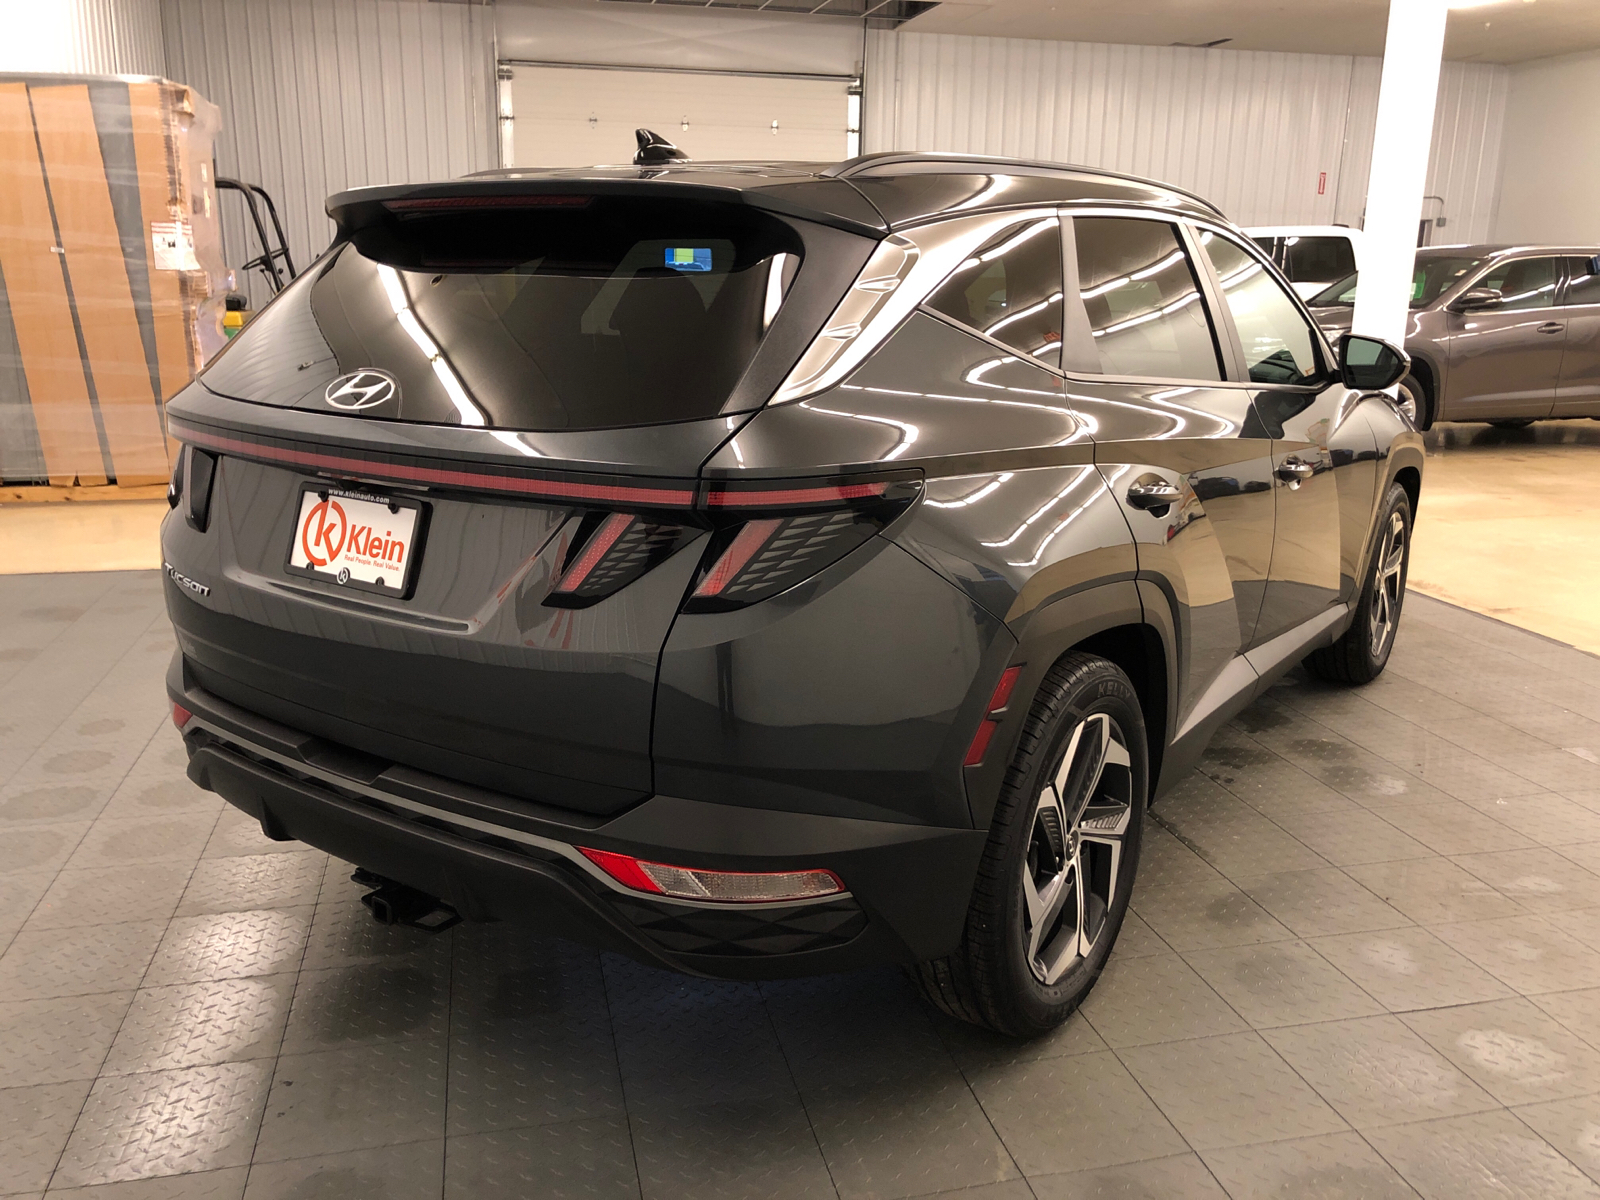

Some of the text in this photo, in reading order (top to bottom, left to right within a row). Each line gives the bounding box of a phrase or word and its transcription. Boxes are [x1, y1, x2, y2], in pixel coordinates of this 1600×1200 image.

[328, 488, 390, 504] www.kleinauto.com
[347, 523, 405, 563] Klein
[344, 554, 354, 562] Real
[373, 560, 384, 568] Real
[1098, 681, 1131, 699] KELLY
